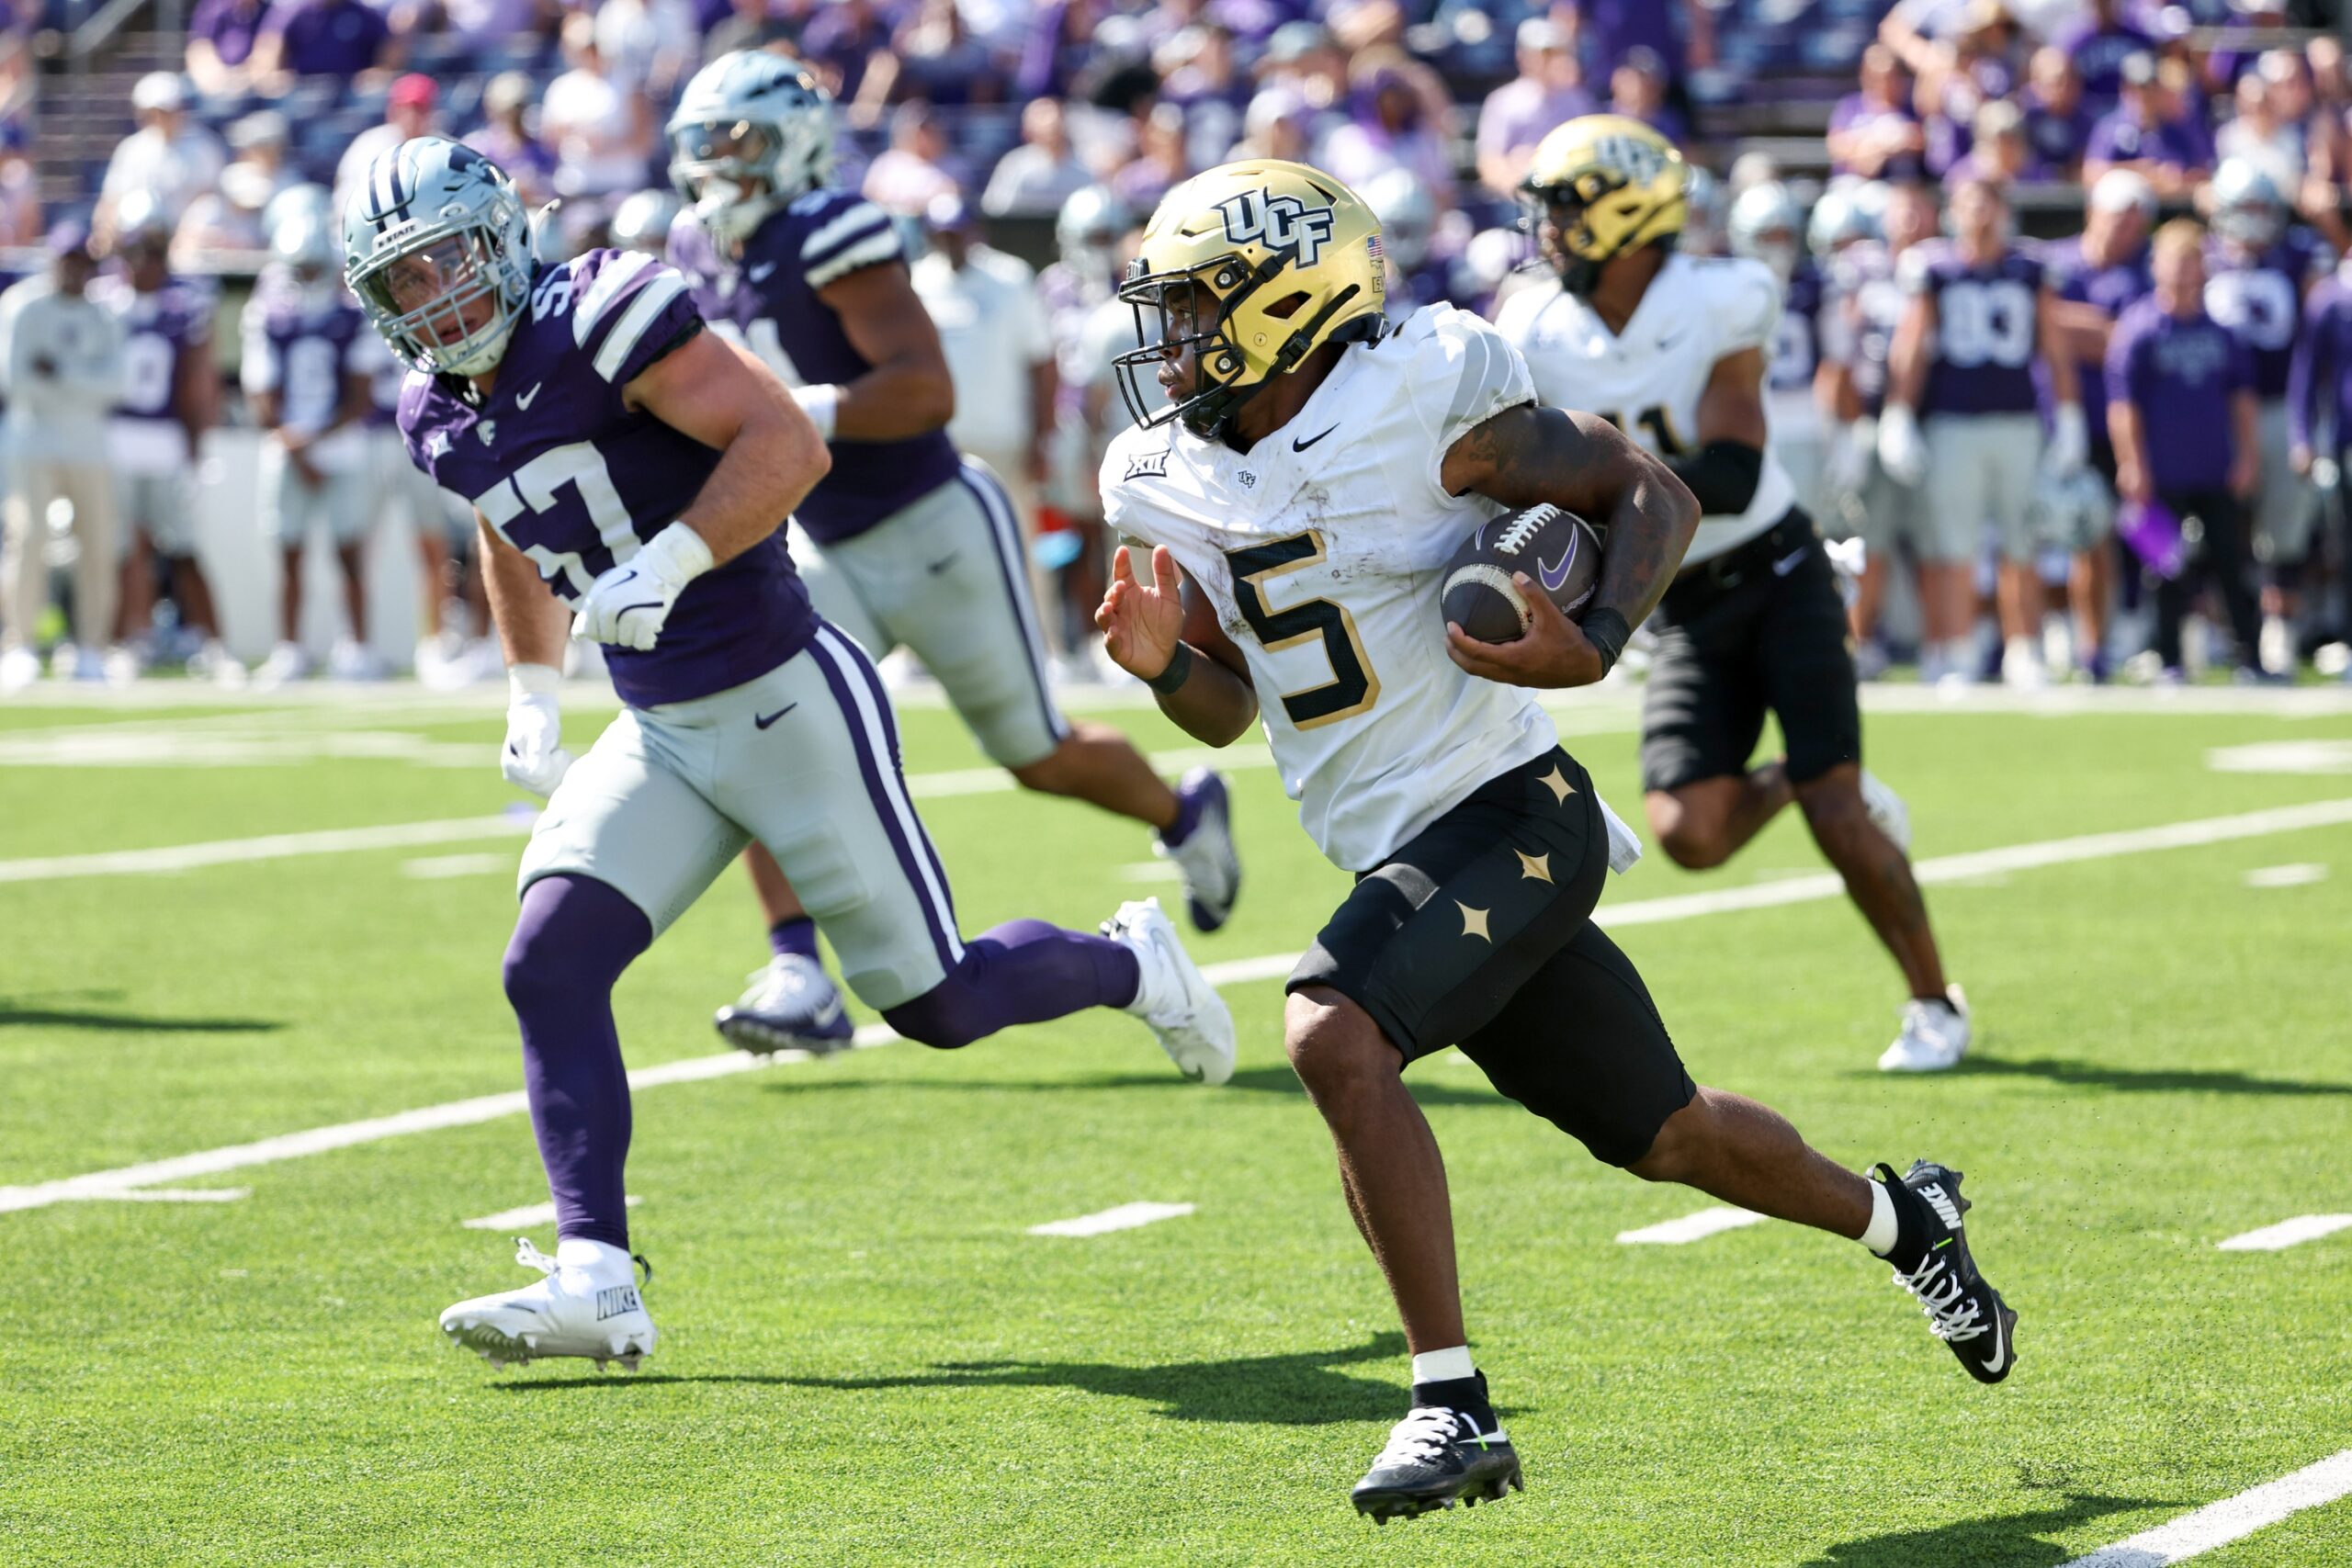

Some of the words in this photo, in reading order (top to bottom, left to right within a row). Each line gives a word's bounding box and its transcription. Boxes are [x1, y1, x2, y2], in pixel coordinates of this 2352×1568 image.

[1210, 185, 1334, 271] UCF
[1124, 447, 1171, 482] XII
[1238, 470, 1256, 489] UCF
[1222, 528, 1382, 732] 5
[1917, 1181, 1962, 1230] NIKE
[596, 1285, 639, 1321] NIKE
